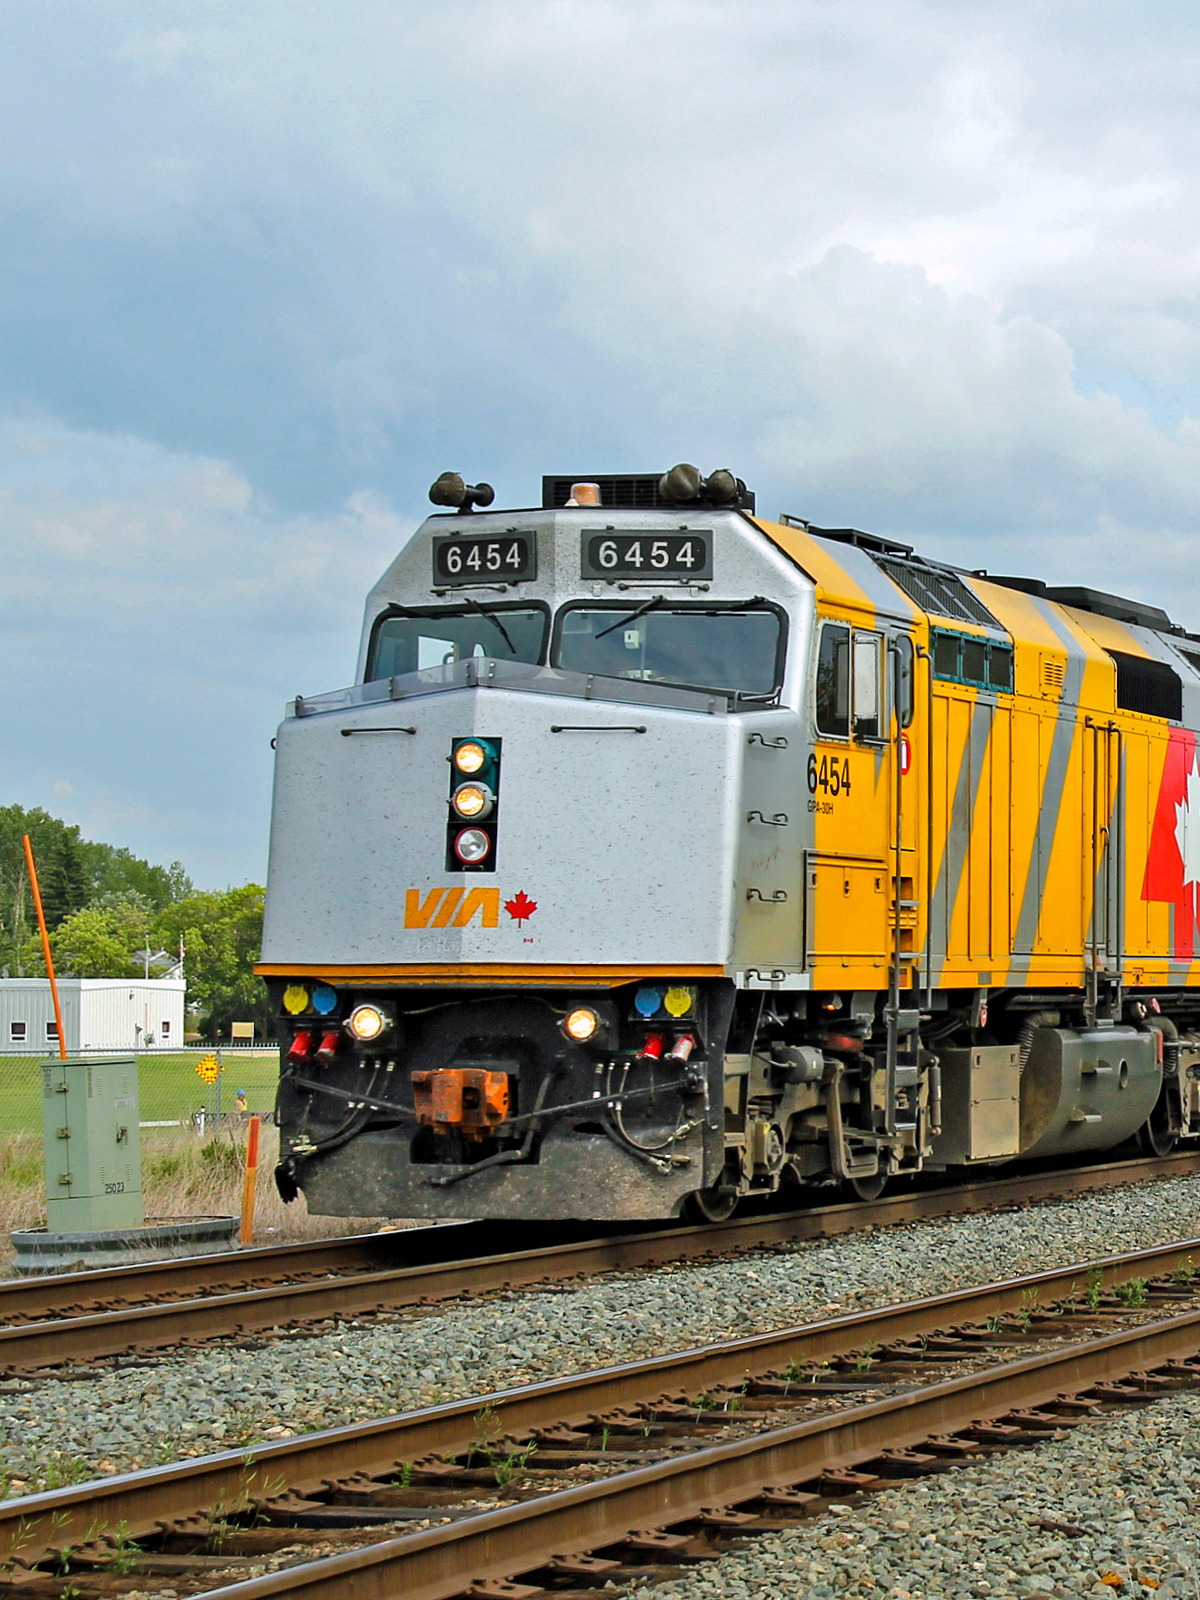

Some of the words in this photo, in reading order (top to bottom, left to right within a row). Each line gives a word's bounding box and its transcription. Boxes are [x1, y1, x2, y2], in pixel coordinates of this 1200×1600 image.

[447, 542, 521, 573] 6454
[598, 541, 695, 568] 6454
[807, 753, 851, 797] 6454
[403, 887, 500, 929] VIA
[105, 1181, 125, 1194] 25023
